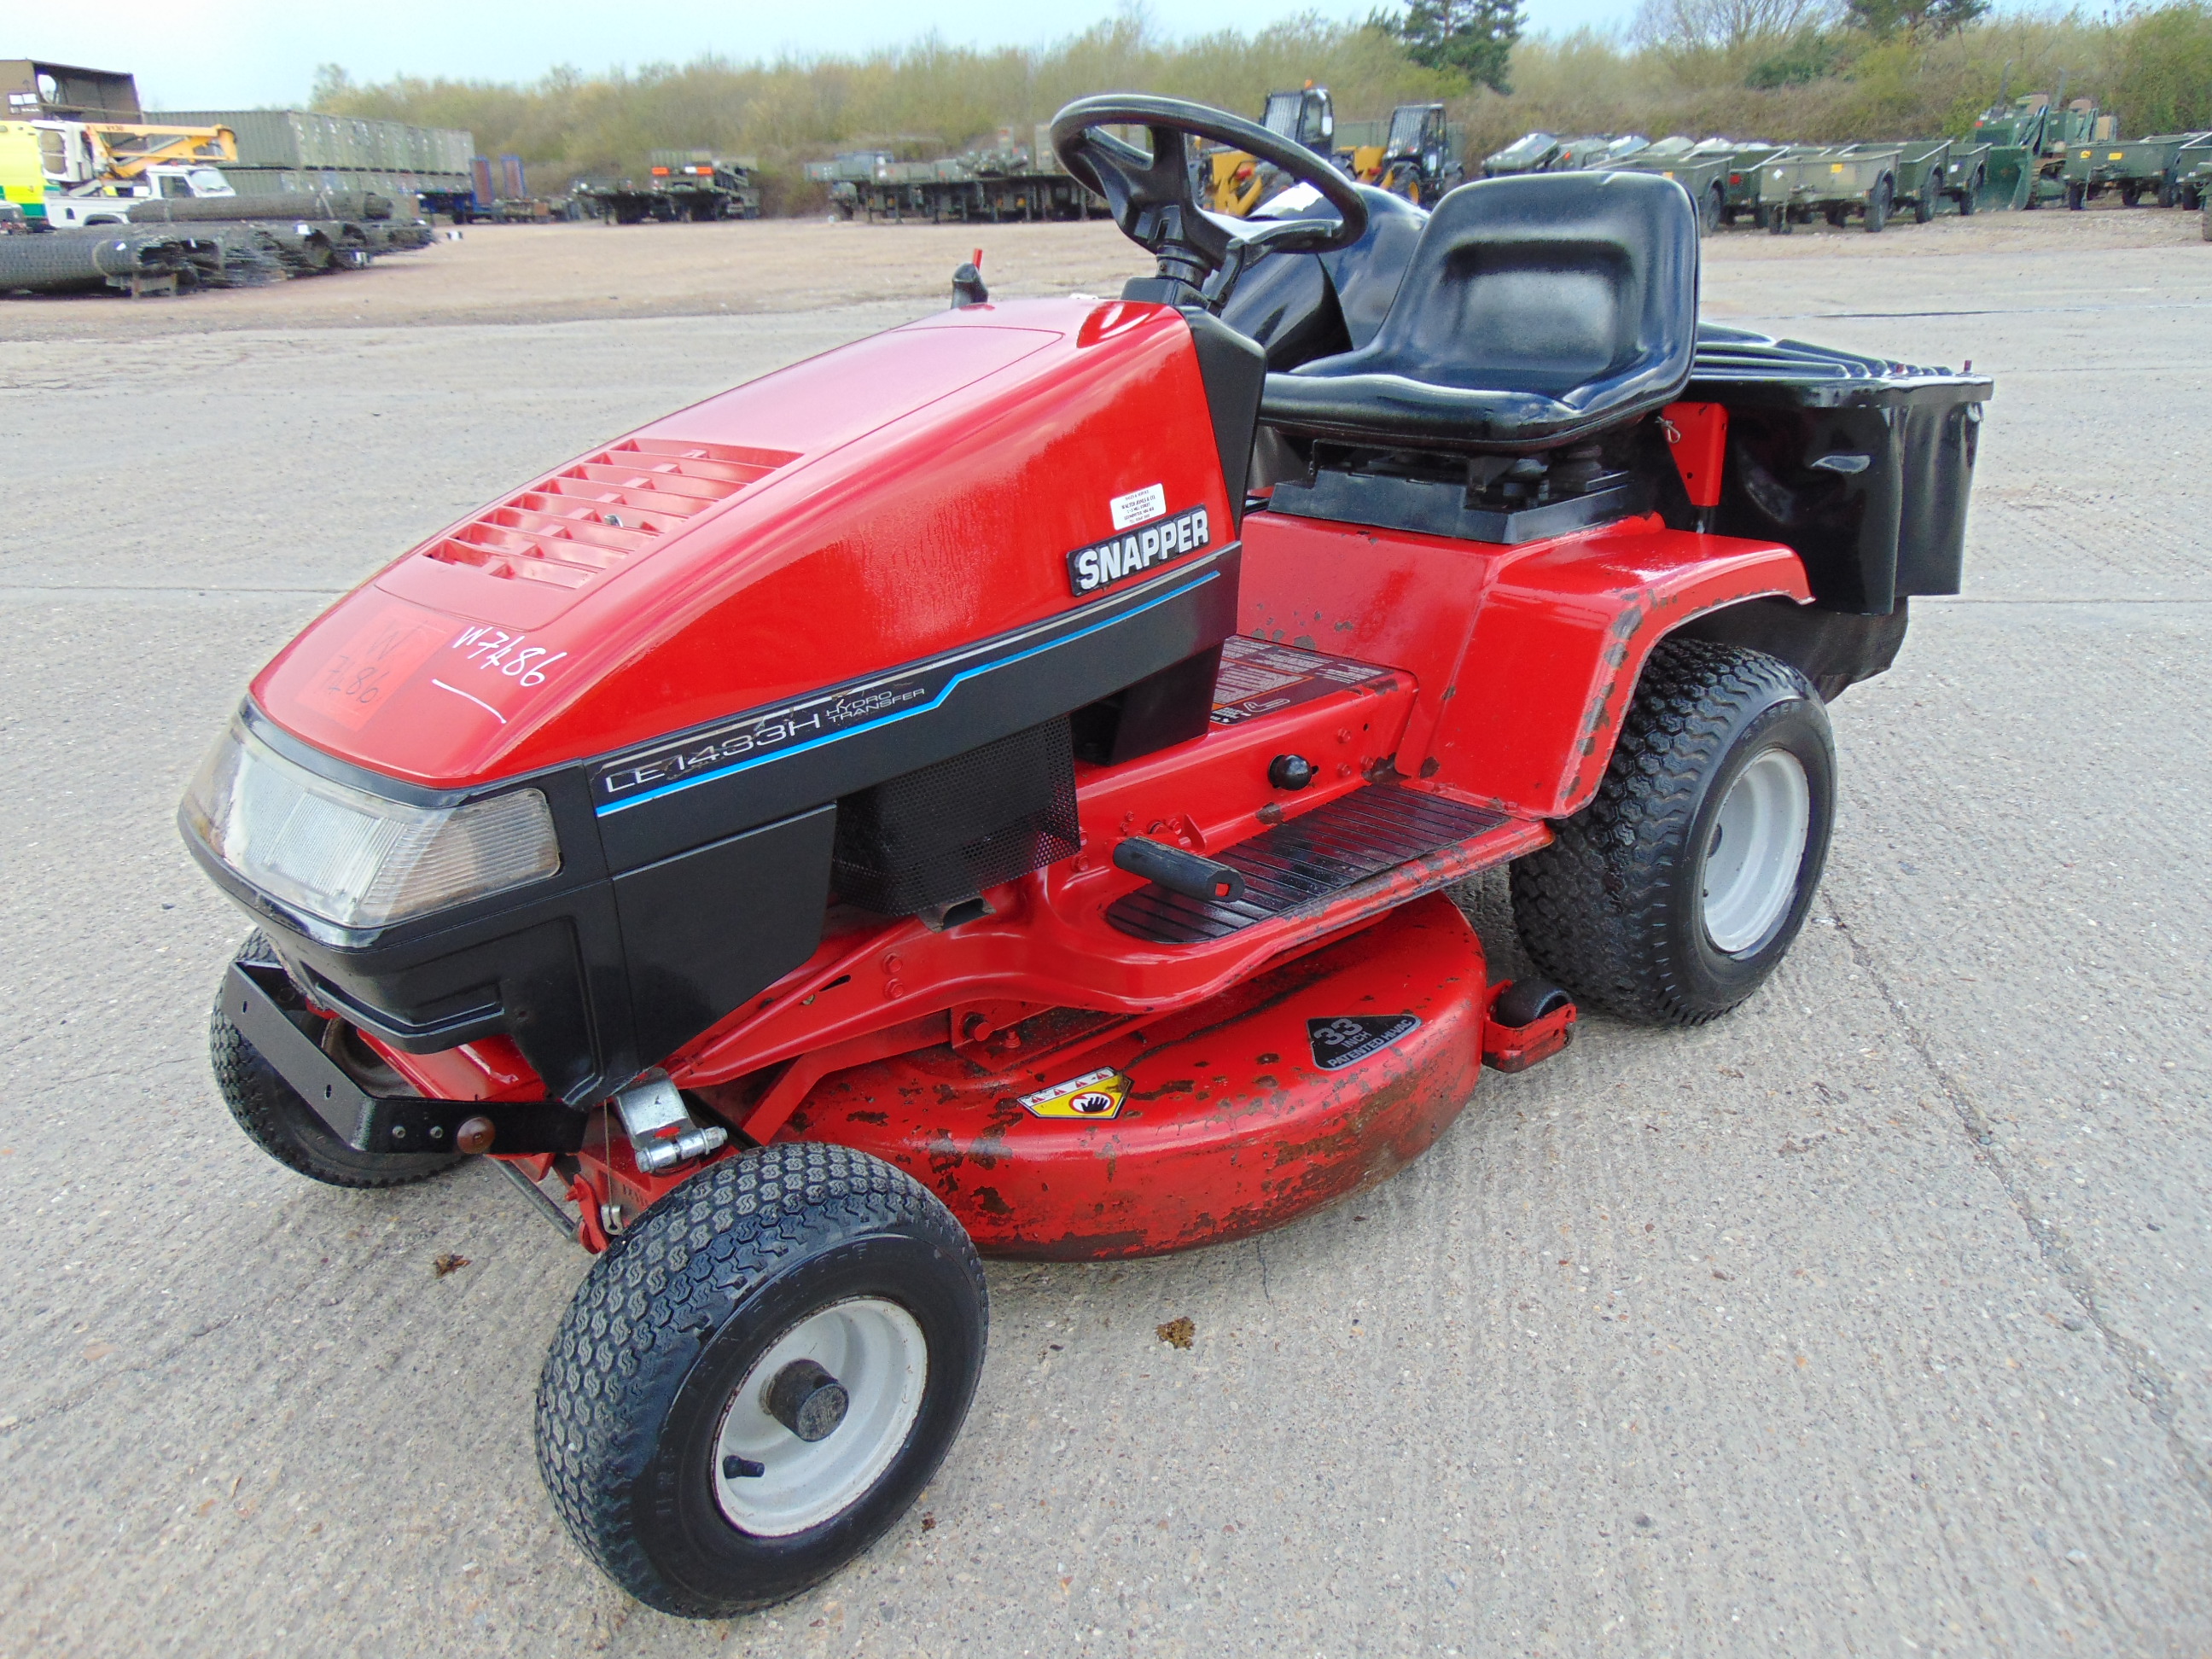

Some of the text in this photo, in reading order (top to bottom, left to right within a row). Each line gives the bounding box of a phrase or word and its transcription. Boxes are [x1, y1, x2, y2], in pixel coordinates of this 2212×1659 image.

[1075, 509, 1209, 590] SNAPPER
[826, 690, 893, 717] HYDRO
[828, 688, 925, 723] TRANSFER
[1313, 1017, 1363, 1045] 33
[1341, 1031, 1372, 1049] INCH
[1327, 1037, 1384, 1068] PATENTED
